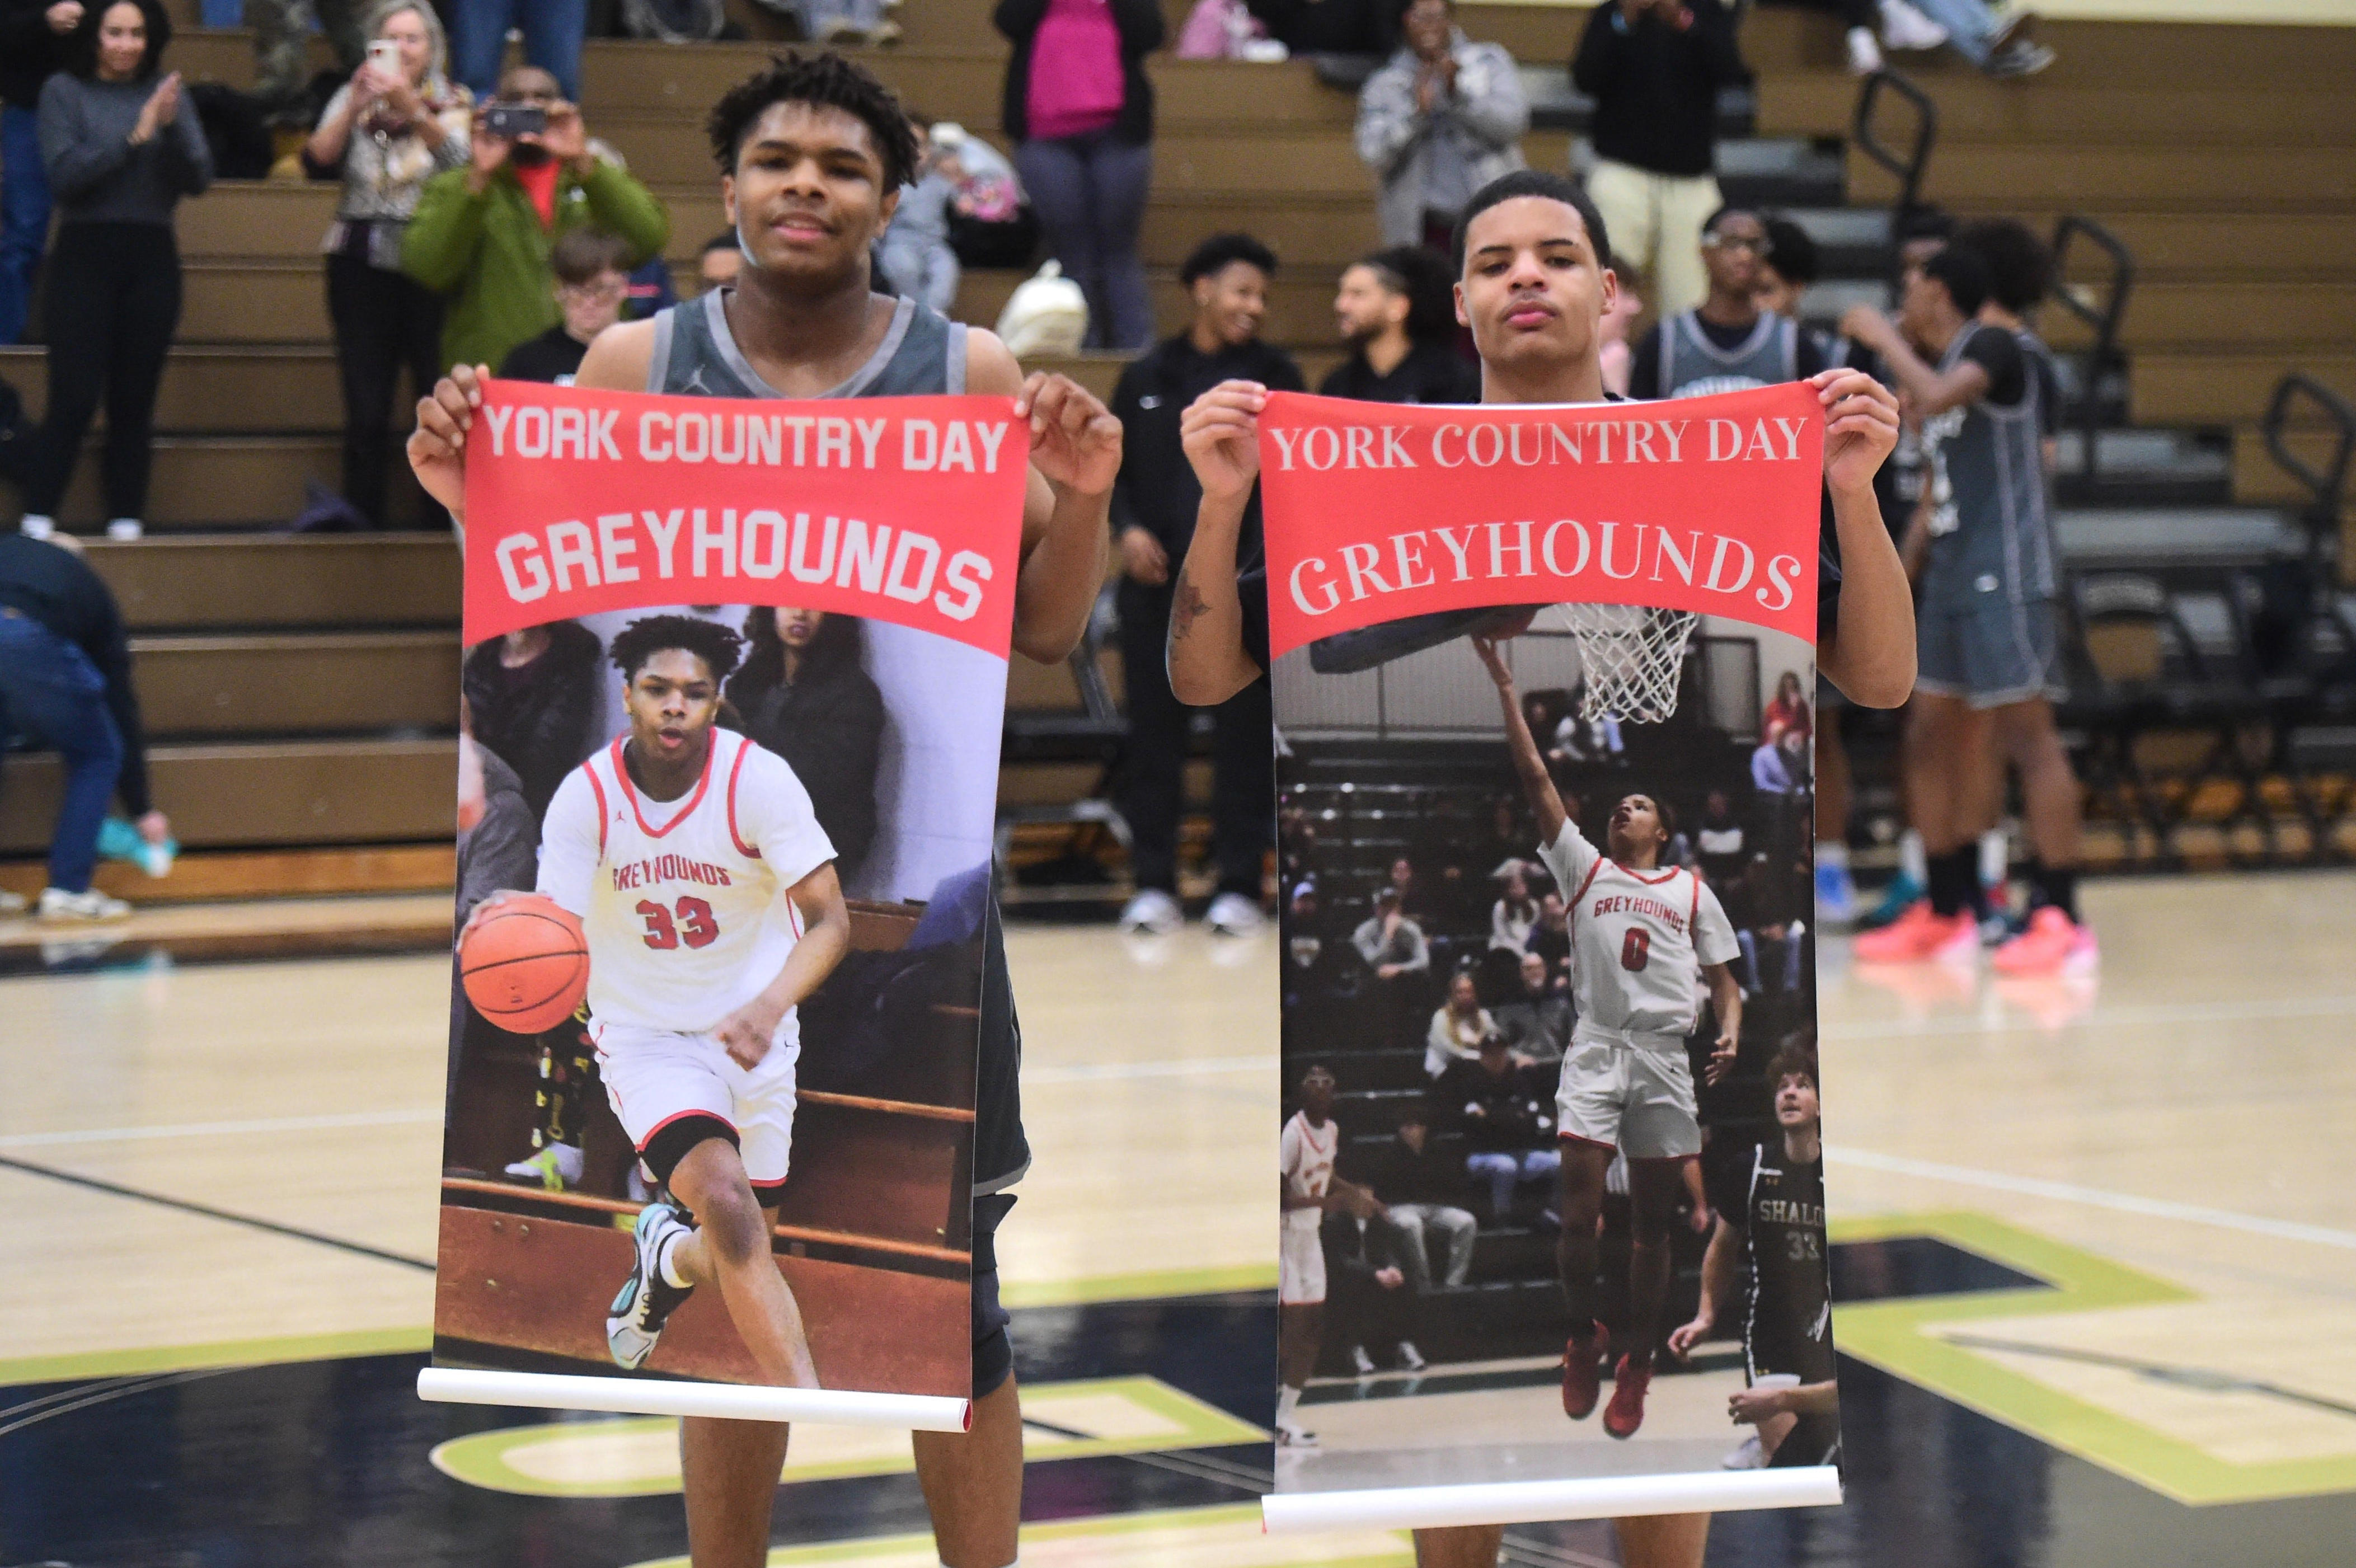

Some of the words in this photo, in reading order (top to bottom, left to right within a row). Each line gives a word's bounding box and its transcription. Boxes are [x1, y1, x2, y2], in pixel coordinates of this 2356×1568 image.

[485, 405, 622, 461] YORK
[640, 411, 888, 469] COUNTRY
[903, 419, 1008, 474] DAY
[1269, 426, 1418, 471] YORK
[1432, 420, 1691, 467] COUNTRY
[1707, 417, 1808, 461] DAY
[495, 508, 993, 622] GREYHOUNDS
[1289, 519, 1801, 616] GREYHOUNDS
[635, 895, 719, 950] 33
[1593, 895, 1685, 935] GREYHOUNDS
[1621, 926, 1651, 971] 0
[1785, 1231, 1821, 1260] 33
